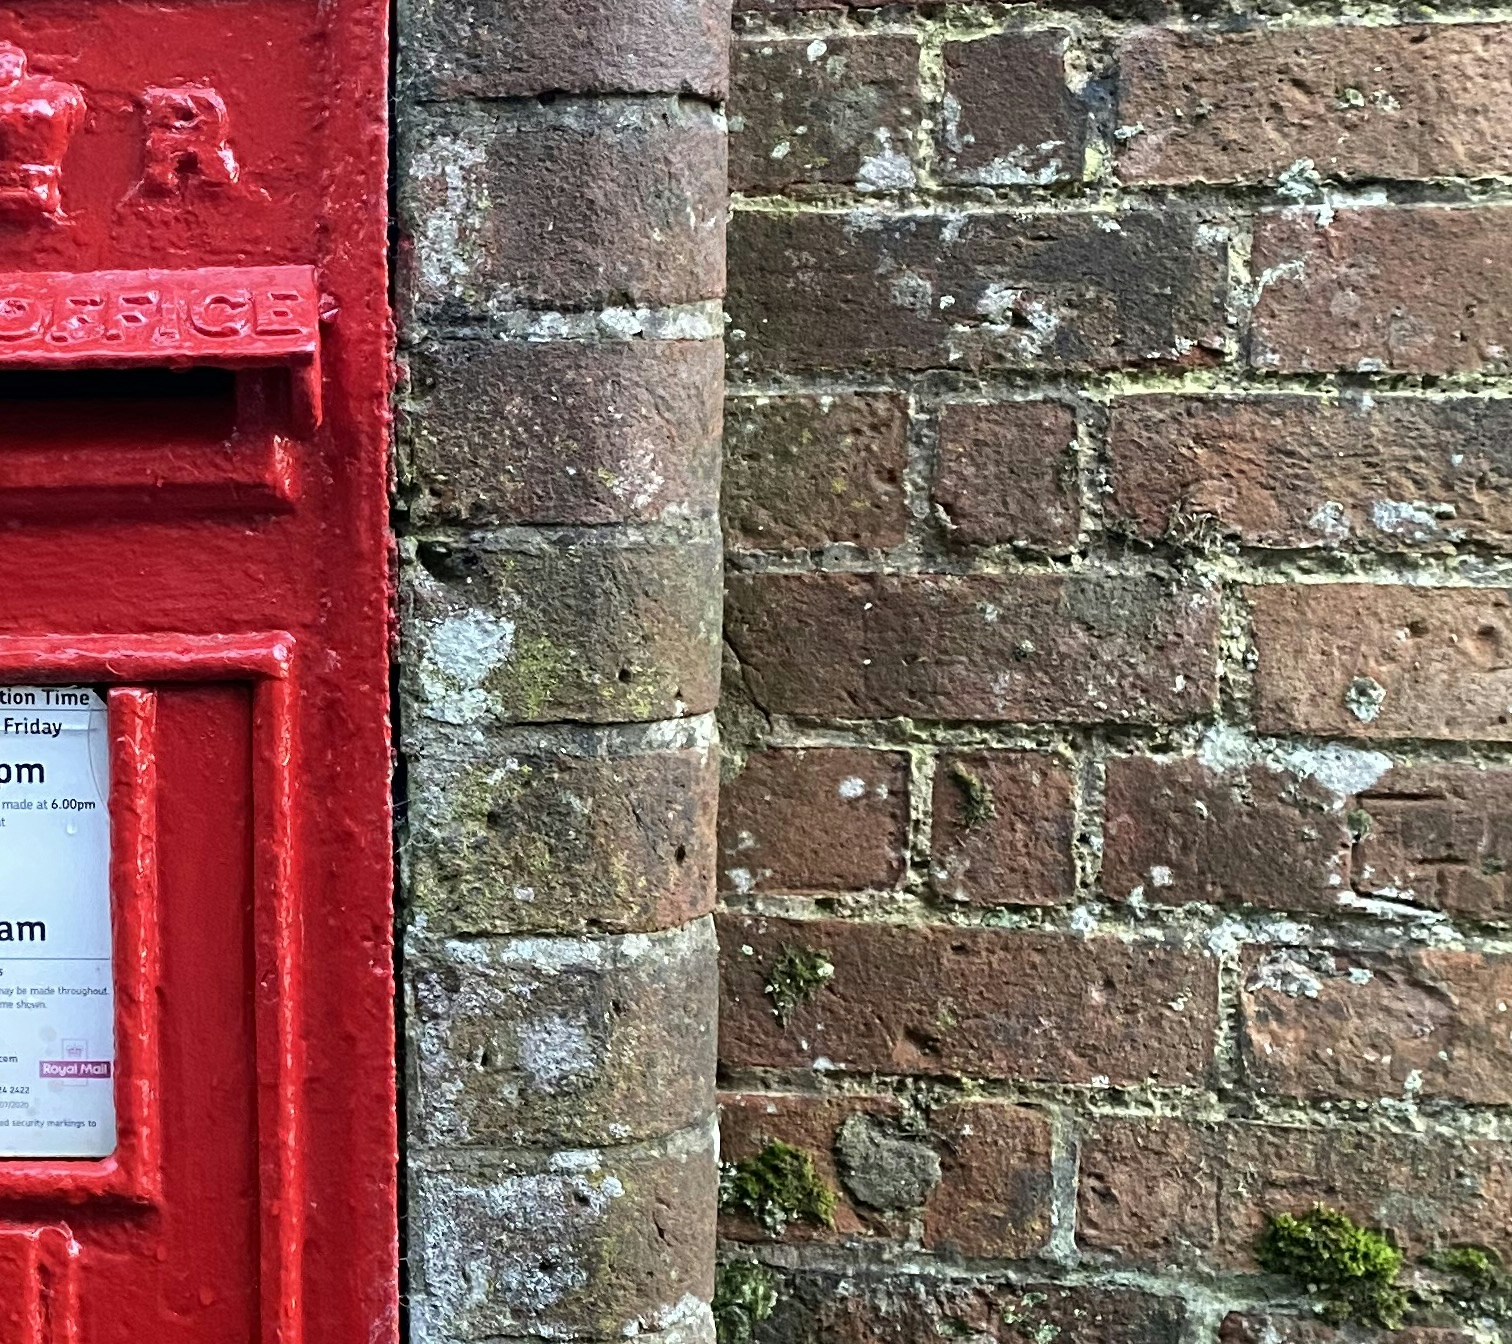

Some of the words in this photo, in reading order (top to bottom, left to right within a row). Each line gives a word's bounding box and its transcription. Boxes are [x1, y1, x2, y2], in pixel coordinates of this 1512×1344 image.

[133, 82, 246, 203] R
[42, 688, 90, 705] Time
[4, 717, 63, 738] Friday
[2, 798, 34, 810] made
[36, 799, 48, 810] at
[51, 798, 96, 812] 6.00pm
[16, 986, 27, 995] be
[30, 986, 55, 995] made
[57, 986, 108, 997] throughout
[41, 1062, 78, 1077] Royal
[79, 1062, 108, 1076] Mail
[47, 1119, 86, 1129] markings
[87, 1119, 97, 1128] to
